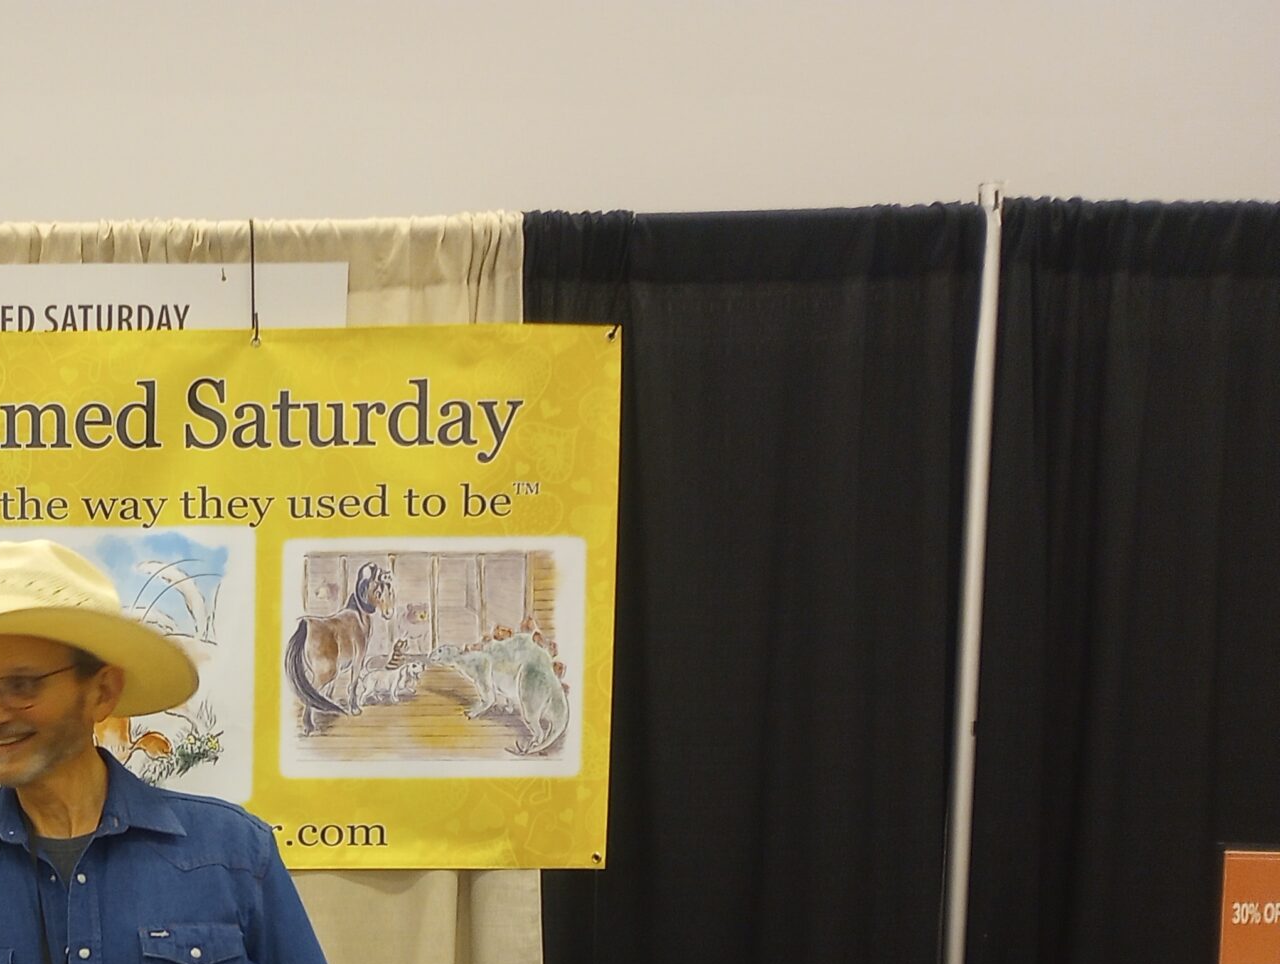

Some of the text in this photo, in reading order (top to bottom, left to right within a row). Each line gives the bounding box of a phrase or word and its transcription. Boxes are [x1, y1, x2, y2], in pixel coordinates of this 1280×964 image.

[44, 304, 191, 332] SATURDAY
[184, 376, 524, 464] Saturday
[0, 486, 69, 522] the
[81, 494, 168, 528] way
[182, 485, 274, 528] they
[289, 484, 390, 519] used
[405, 488, 446, 518] to
[1232, 901, 1262, 925] 30%
